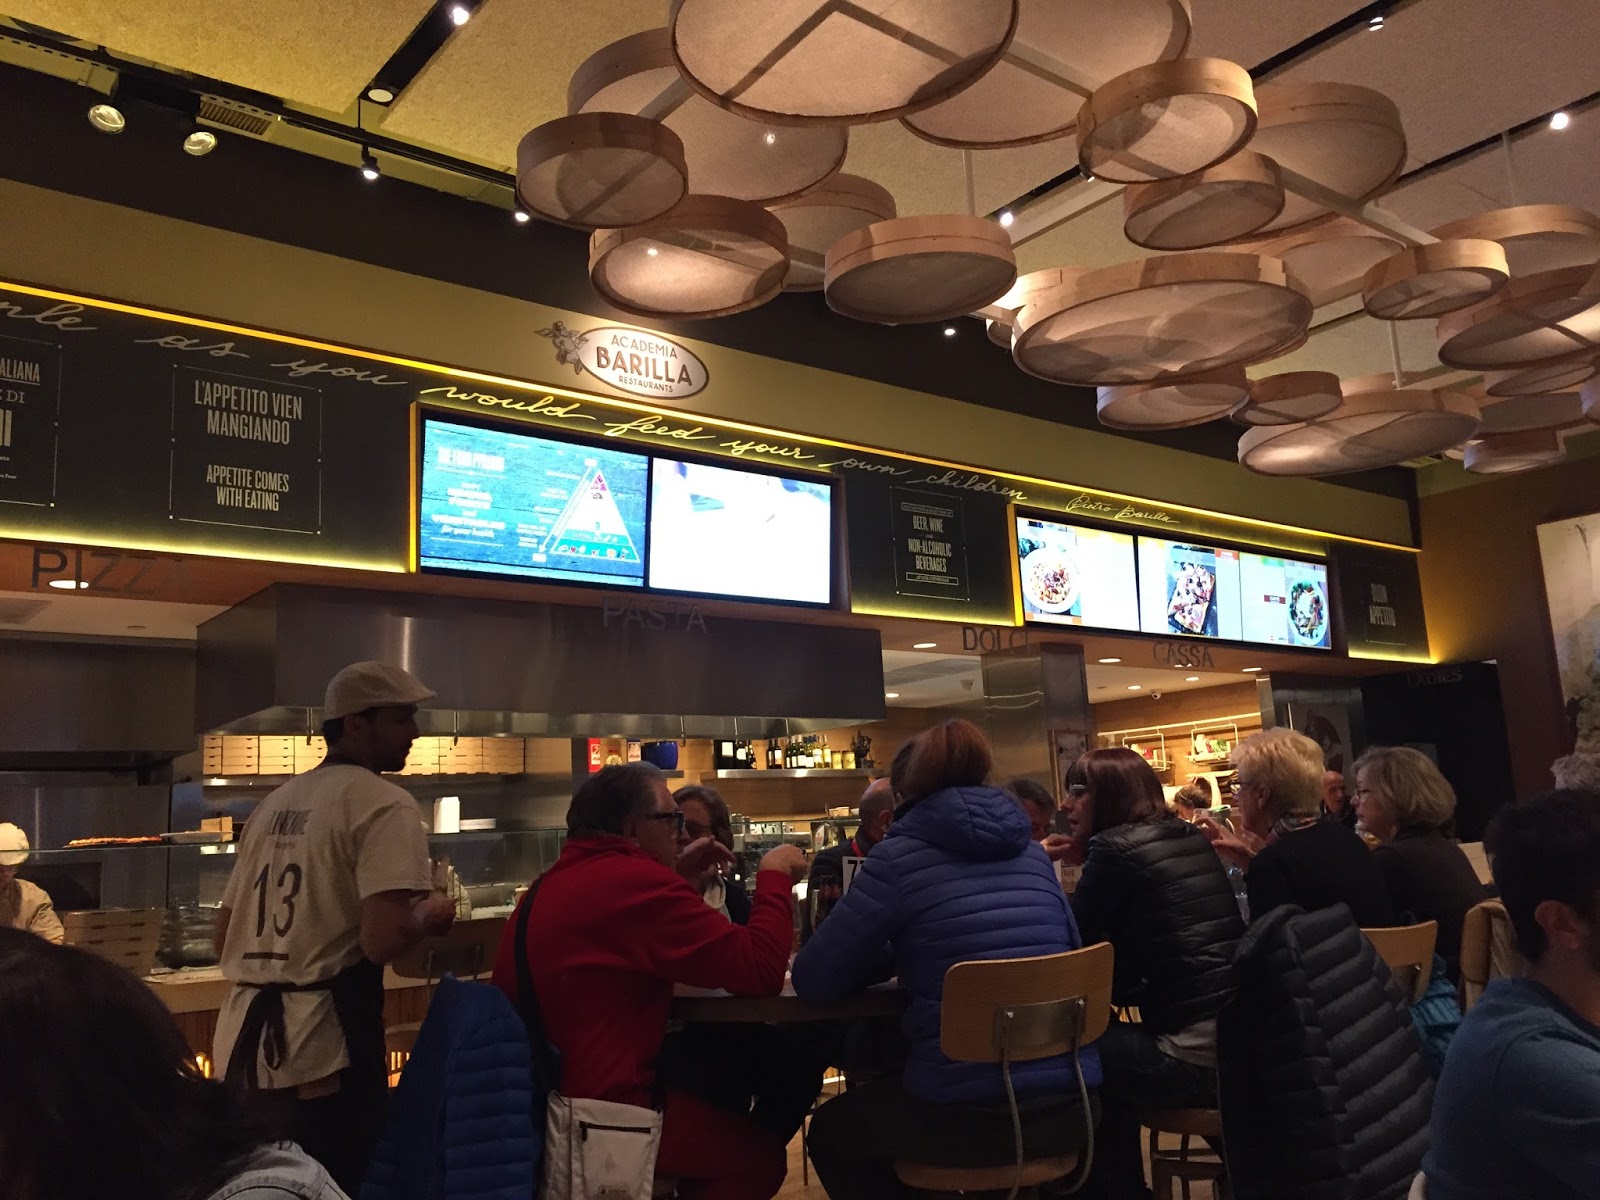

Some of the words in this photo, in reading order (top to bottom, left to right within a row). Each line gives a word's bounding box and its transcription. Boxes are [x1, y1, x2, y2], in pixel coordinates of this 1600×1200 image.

[611, 334, 678, 359] ACADEMIA
[596, 345, 693, 387] BARILLA
[618, 375, 674, 393] RESTAURANTS
[194, 380, 269, 415] L'APPETITO
[271, 392, 303, 420] VIEN
[133, 335, 250, 359] as
[270, 359, 409, 385] you
[419, 386, 597, 420] would
[604, 415, 716, 437] feed
[719, 439, 817, 460] your
[818, 457, 912, 477] own
[905, 470, 1028, 500] children
[207, 409, 290, 445] MANGIANDO
[206, 464, 253, 488] APPETITE
[254, 470, 290, 492] COMES
[216, 486, 243, 508] WITH
[244, 490, 280, 511] EATING
[1065, 493, 1119, 511] Pietro
[1114, 504, 1180, 523] Barilla
[929, 517, 944, 533] WINE
[907, 538, 953, 558] NON-ALCOHOLIC
[32, 546, 193, 597] PIZZ
[915, 555, 947, 573] BEVERAGES
[602, 596, 708, 634] PASTA
[1153, 642, 1215, 668] CASSA
[253, 862, 303, 938] 13
